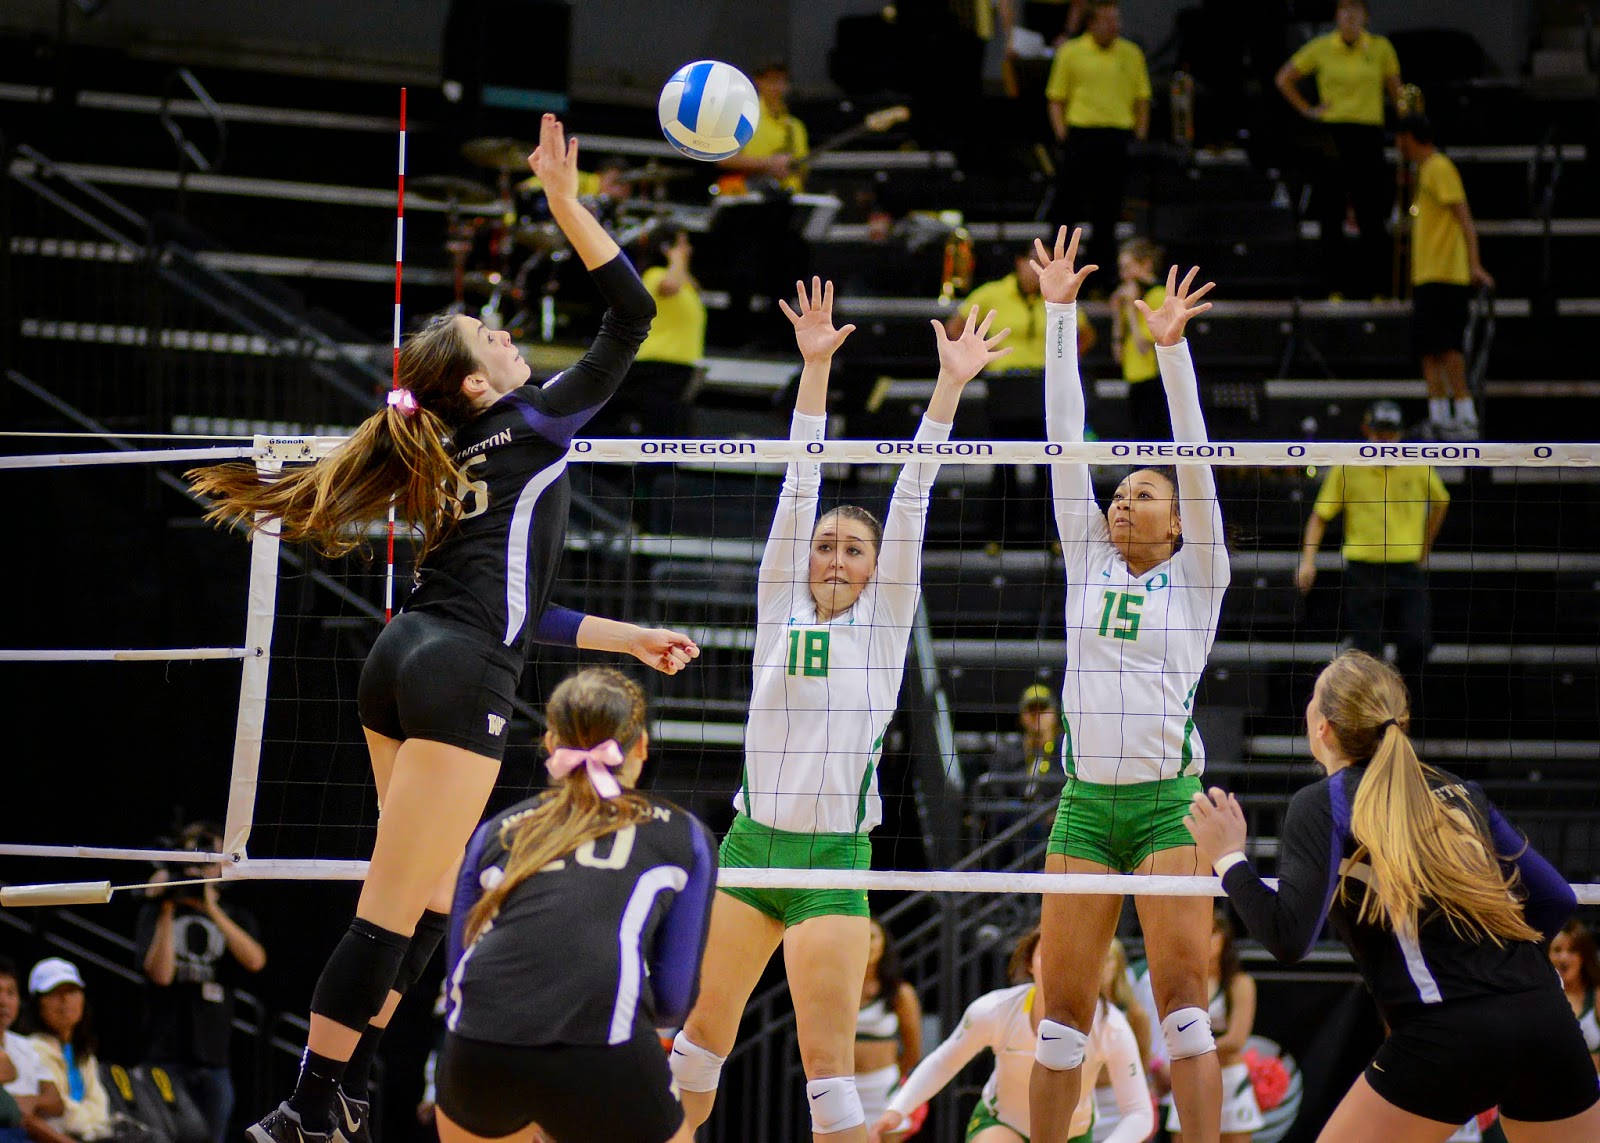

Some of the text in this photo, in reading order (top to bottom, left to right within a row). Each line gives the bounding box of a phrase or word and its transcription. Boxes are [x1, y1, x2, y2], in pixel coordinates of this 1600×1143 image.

[641, 442, 756, 454] OREGON
[876, 443, 993, 455] OREGON
[1112, 445, 1235, 457] OREGON
[1359, 446, 1480, 459] OREGON
[1098, 590, 1145, 641] 15
[787, 629, 830, 678] 18
